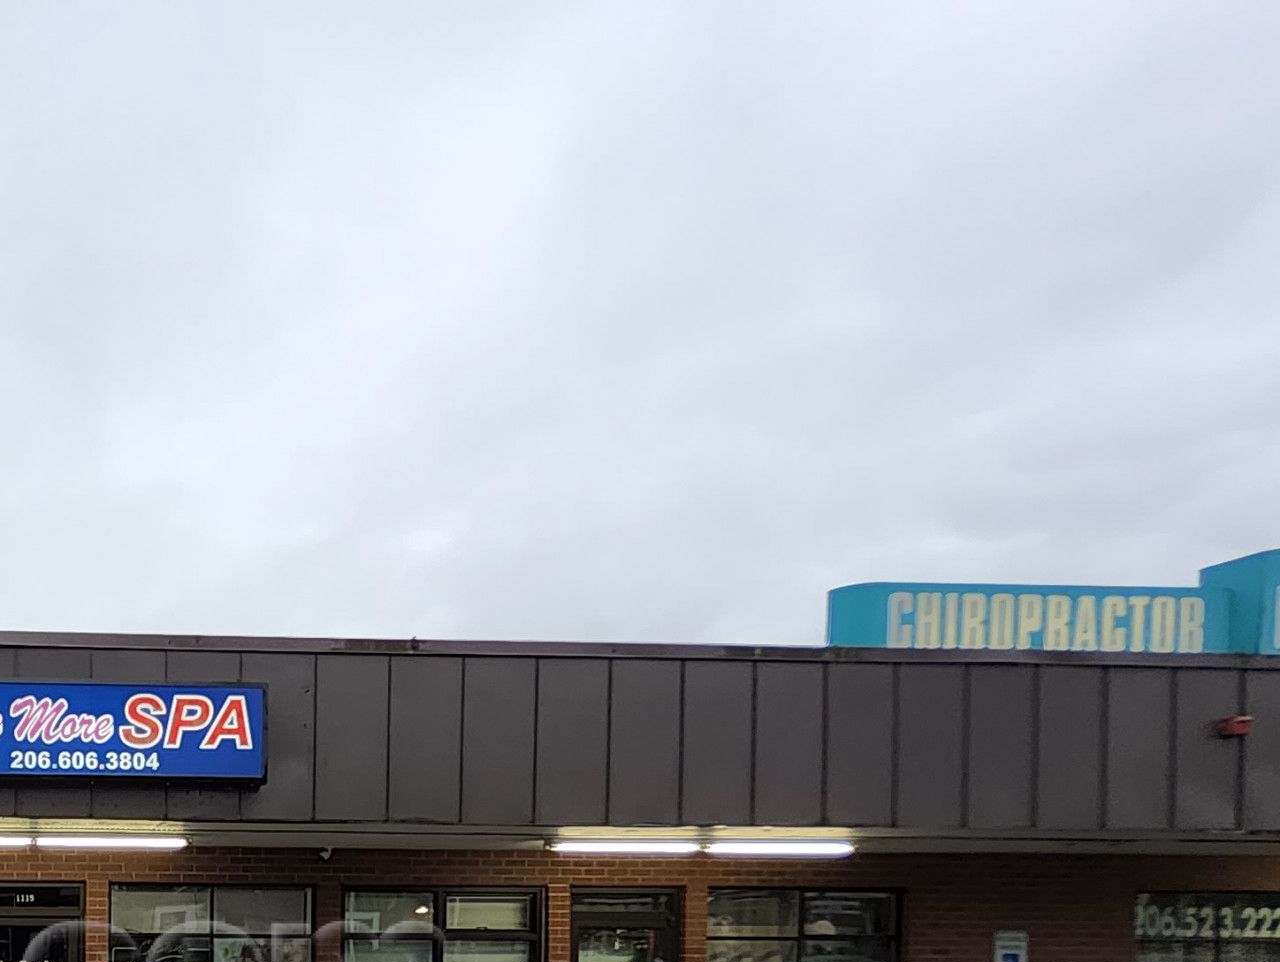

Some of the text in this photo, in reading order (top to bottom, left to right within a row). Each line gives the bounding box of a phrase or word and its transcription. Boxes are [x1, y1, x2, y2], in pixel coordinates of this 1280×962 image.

[887, 591, 1205, 653] CHIROPRACTOR
[8, 695, 114, 744] More
[118, 693, 253, 750] SPA
[10, 751, 160, 771] 206.606.3804
